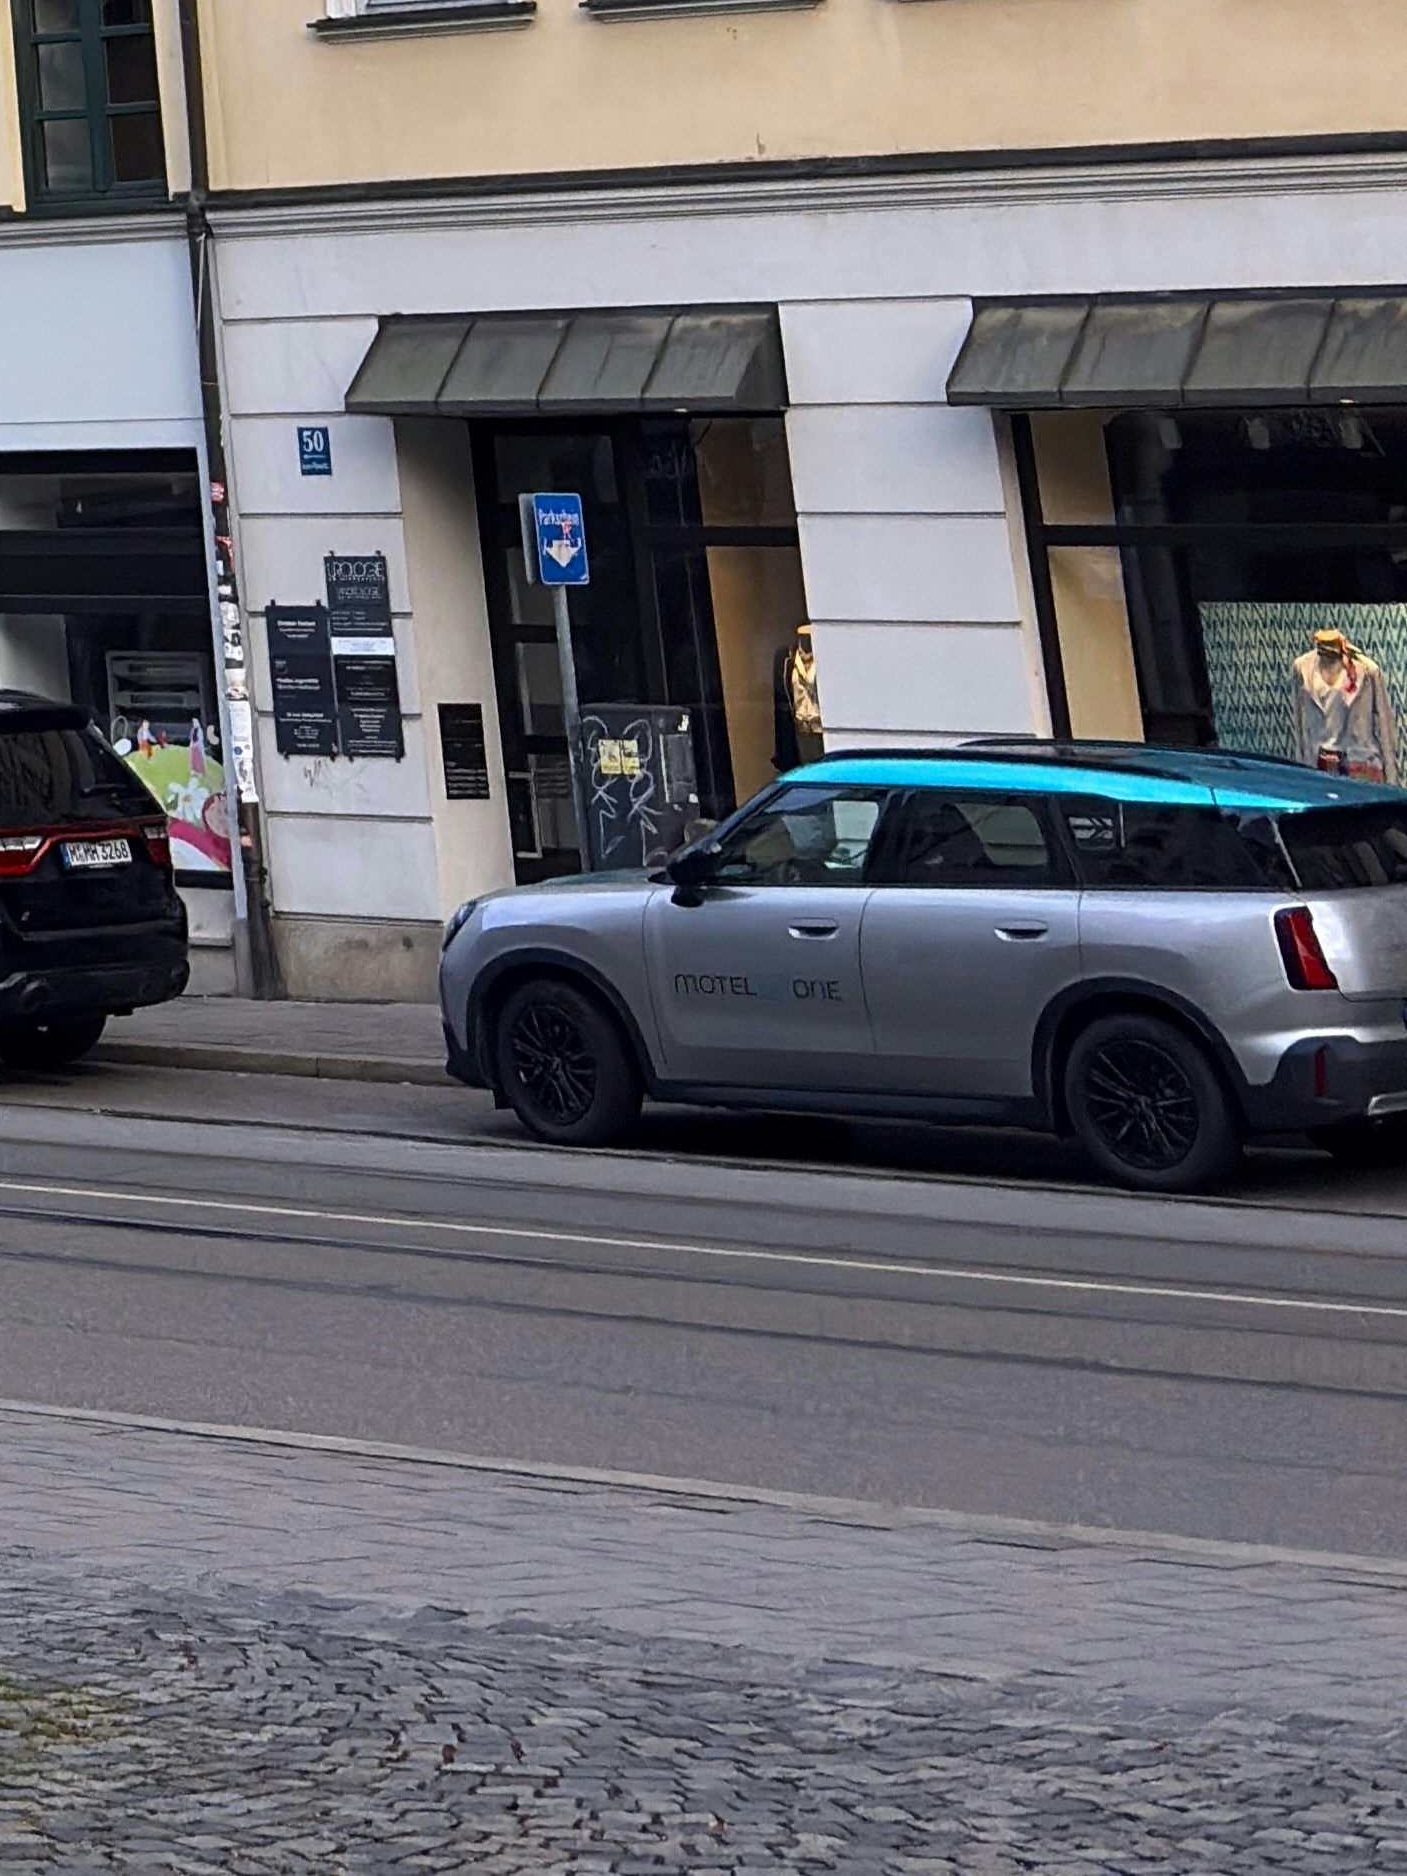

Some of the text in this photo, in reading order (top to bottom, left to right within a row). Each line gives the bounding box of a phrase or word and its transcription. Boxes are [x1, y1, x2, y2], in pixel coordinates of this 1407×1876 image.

[302, 430, 324, 452] 50
[99, 840, 130, 860] 3268
[674, 973, 758, 996] MOTEL
